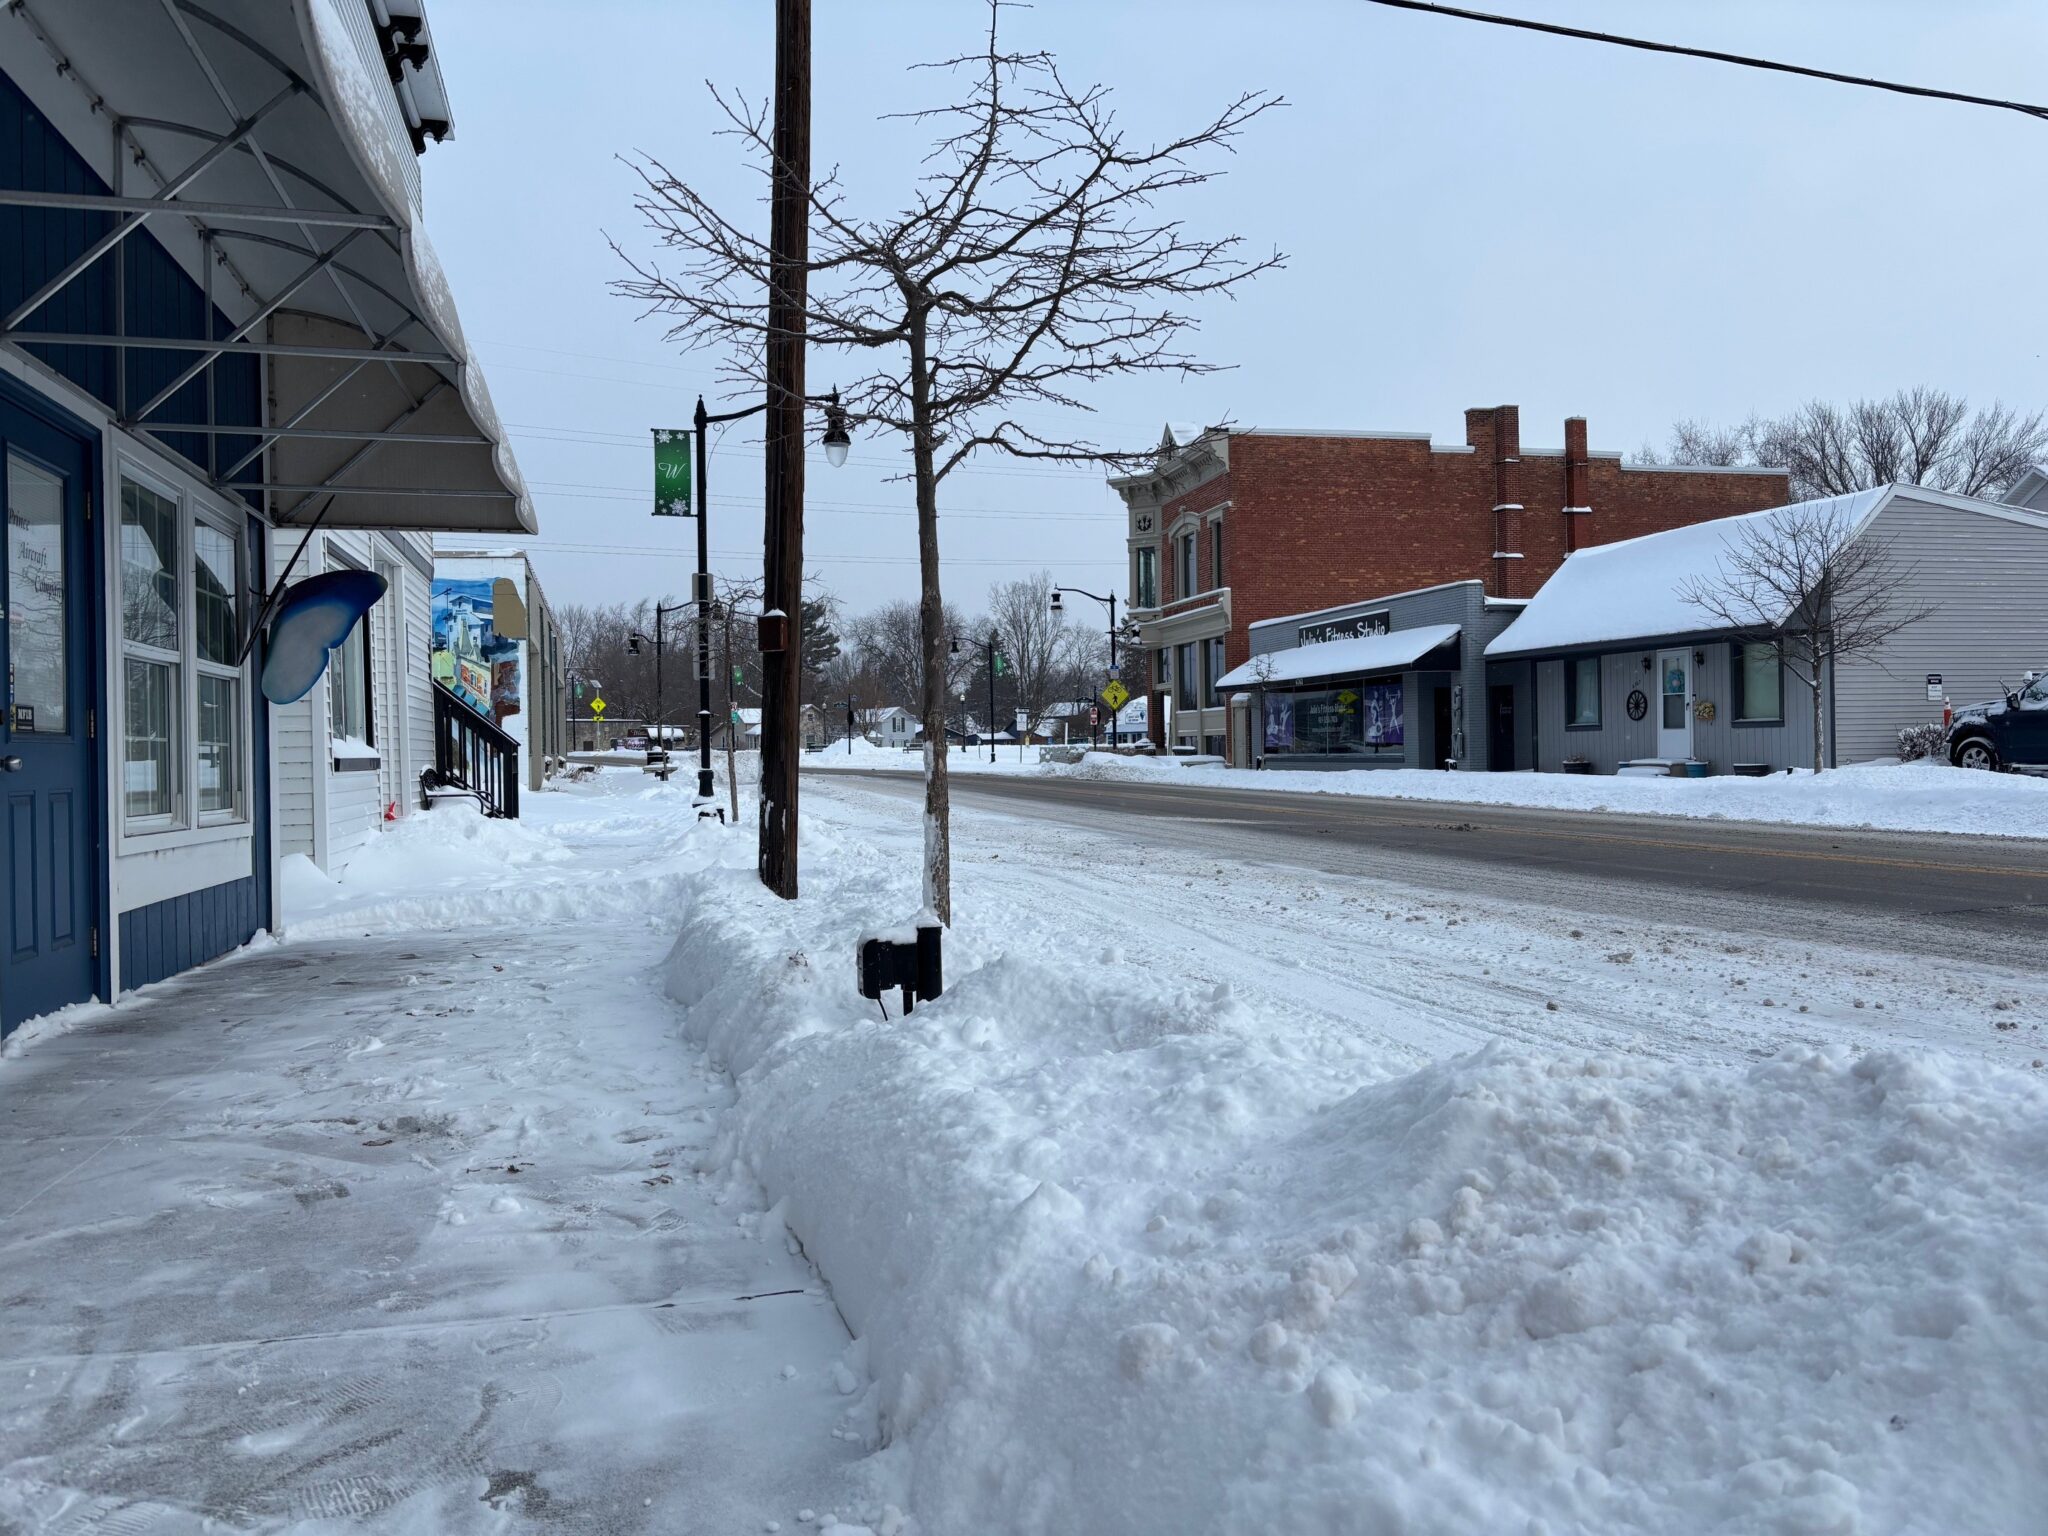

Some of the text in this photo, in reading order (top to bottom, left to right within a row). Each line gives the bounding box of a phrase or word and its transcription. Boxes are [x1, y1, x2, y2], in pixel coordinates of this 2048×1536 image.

[658, 462, 687, 479] W
[8, 507, 30, 531] Prince
[18, 541, 48, 570] Aircraft
[1300, 619, 1386, 647] Julie's Fitness Studio
[1451, 685, 1463, 760] GYM
